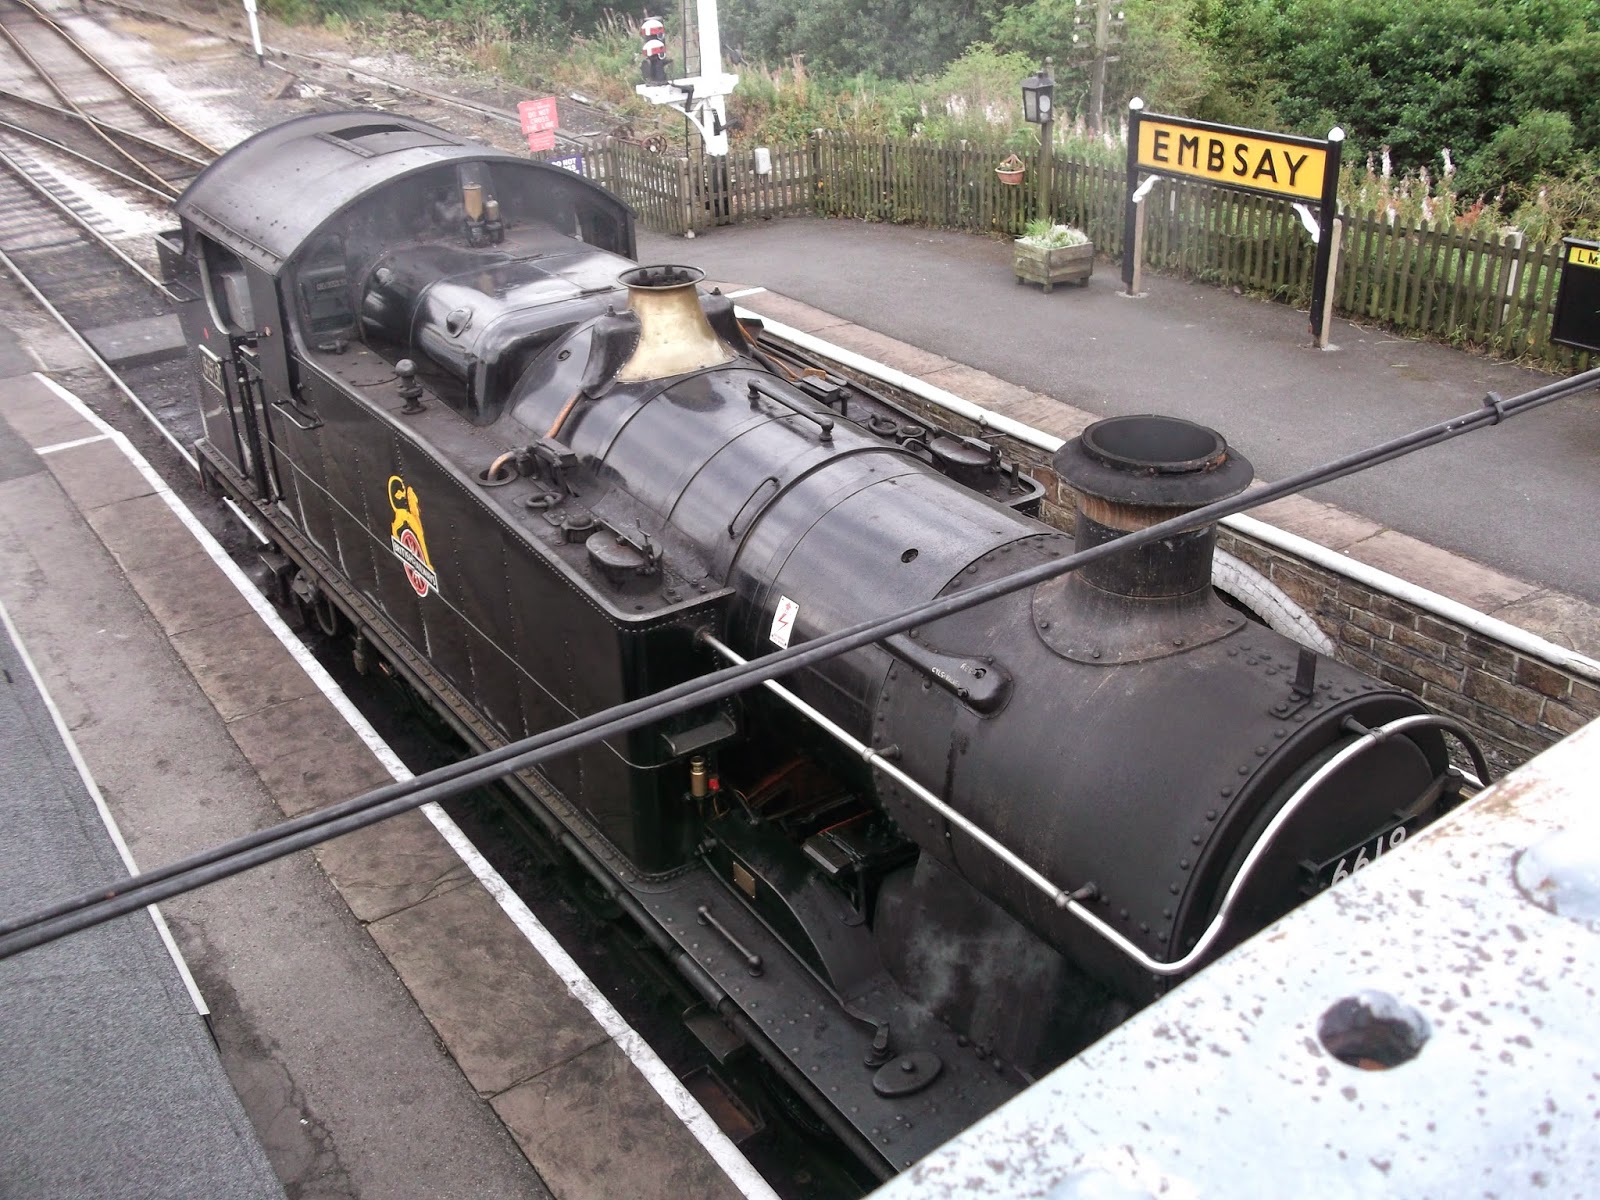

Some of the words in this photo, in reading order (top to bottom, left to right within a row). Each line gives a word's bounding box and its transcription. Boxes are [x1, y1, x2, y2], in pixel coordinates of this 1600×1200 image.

[530, 115, 550, 125] CROSS
[562, 157, 577, 166] NOT
[1153, 130, 1308, 186] EMBSAY
